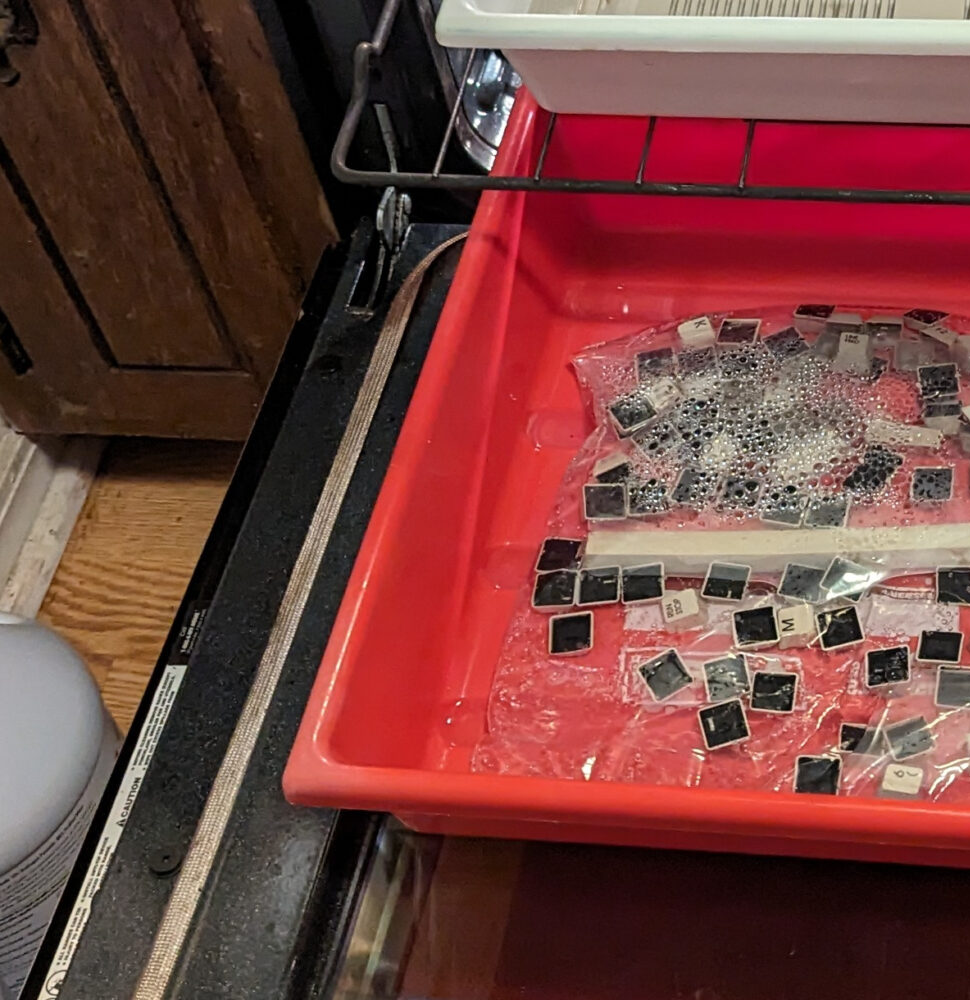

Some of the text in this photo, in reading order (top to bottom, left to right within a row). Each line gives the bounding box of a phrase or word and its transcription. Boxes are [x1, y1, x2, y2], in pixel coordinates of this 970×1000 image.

[694, 319, 707, 329] K
[781, 618, 796, 632] M
[120, 776, 142, 818] CAUTION
